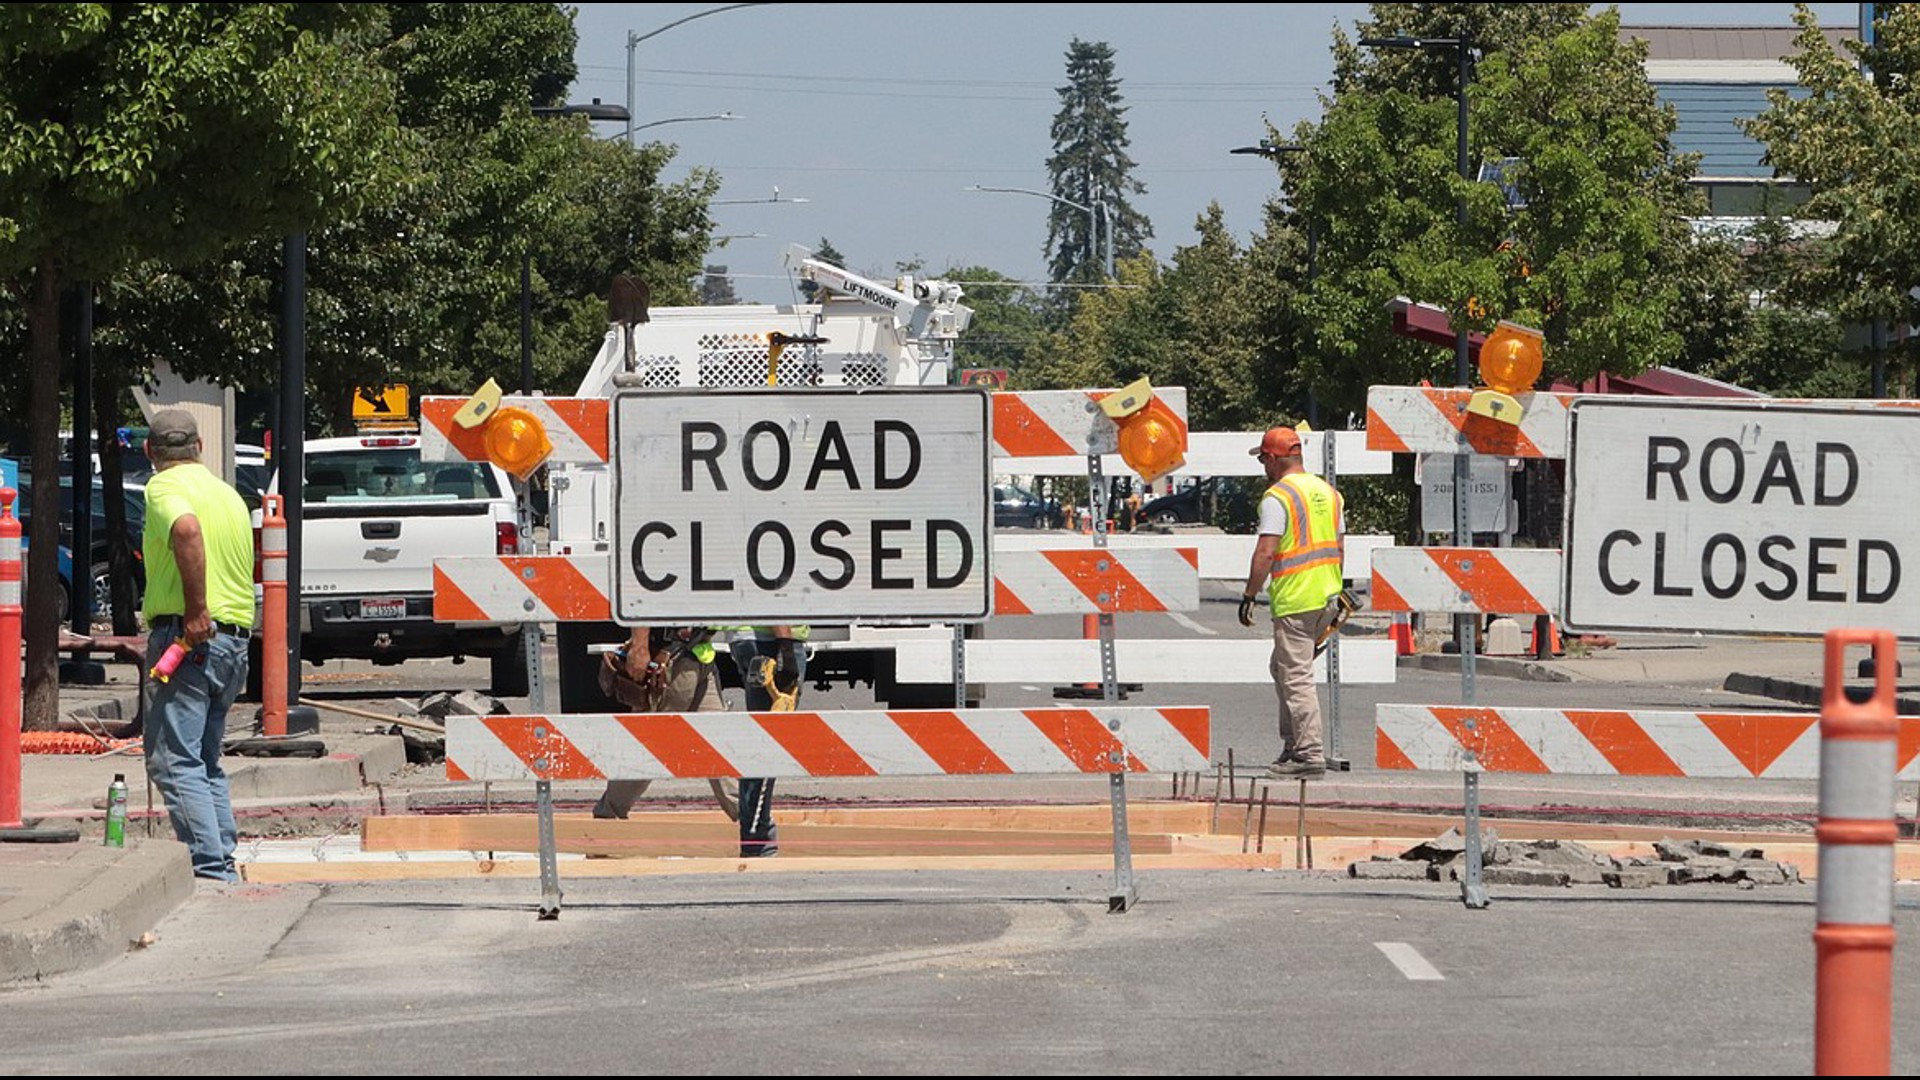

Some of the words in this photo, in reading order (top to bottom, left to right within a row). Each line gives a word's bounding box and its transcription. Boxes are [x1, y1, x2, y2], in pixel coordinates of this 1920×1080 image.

[680, 419, 922, 492] ROAD
[1646, 435, 1859, 507] ROAD
[631, 519, 975, 592] CLOSED
[1598, 529, 1902, 604] CLOSED
